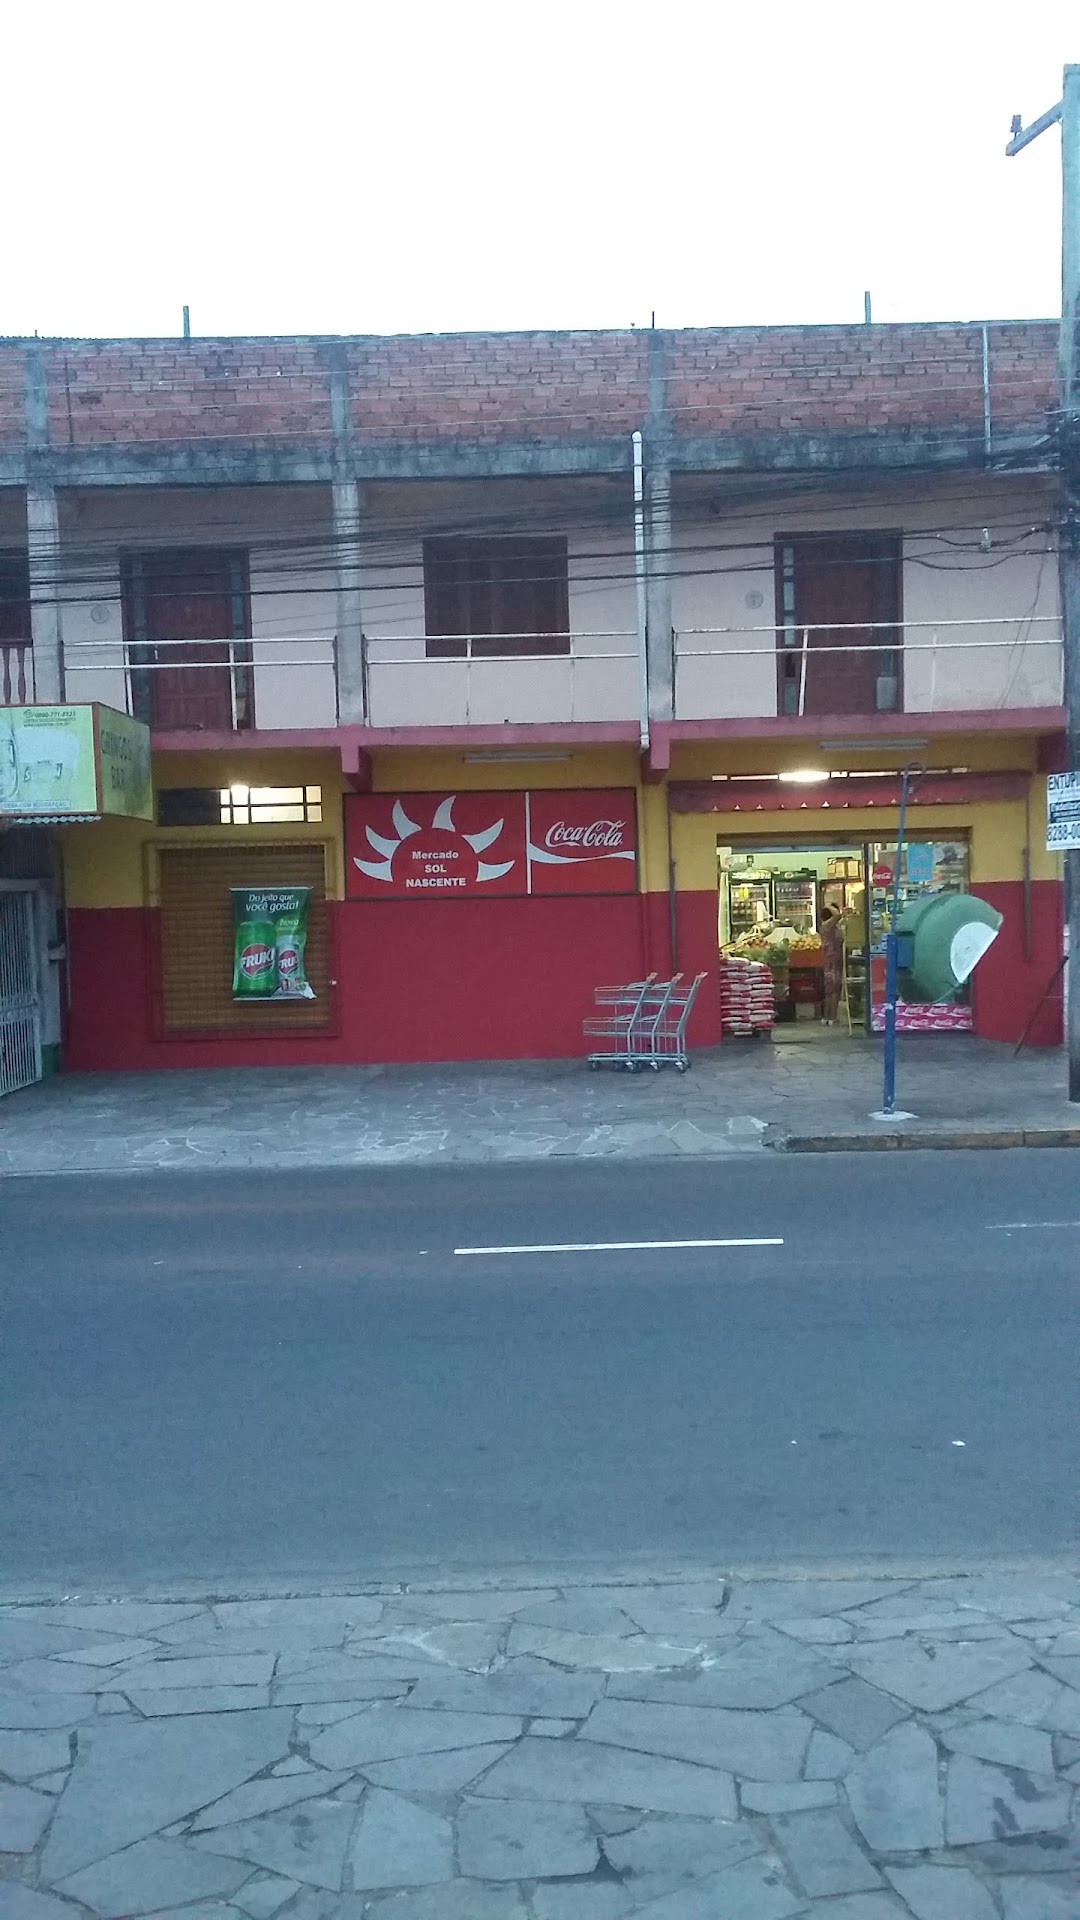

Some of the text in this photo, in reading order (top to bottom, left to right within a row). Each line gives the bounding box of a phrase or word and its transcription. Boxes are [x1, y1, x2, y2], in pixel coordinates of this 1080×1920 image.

[545, 820, 626, 848] Coca-Cola
[411, 850, 459, 860] Mercado
[424, 864, 447, 874] SOL
[406, 877, 466, 888] NASCENTE
[261, 894, 278, 903] jeito
[246, 901, 299, 913] você gosta!
[241, 947, 275, 968] FRUKI
